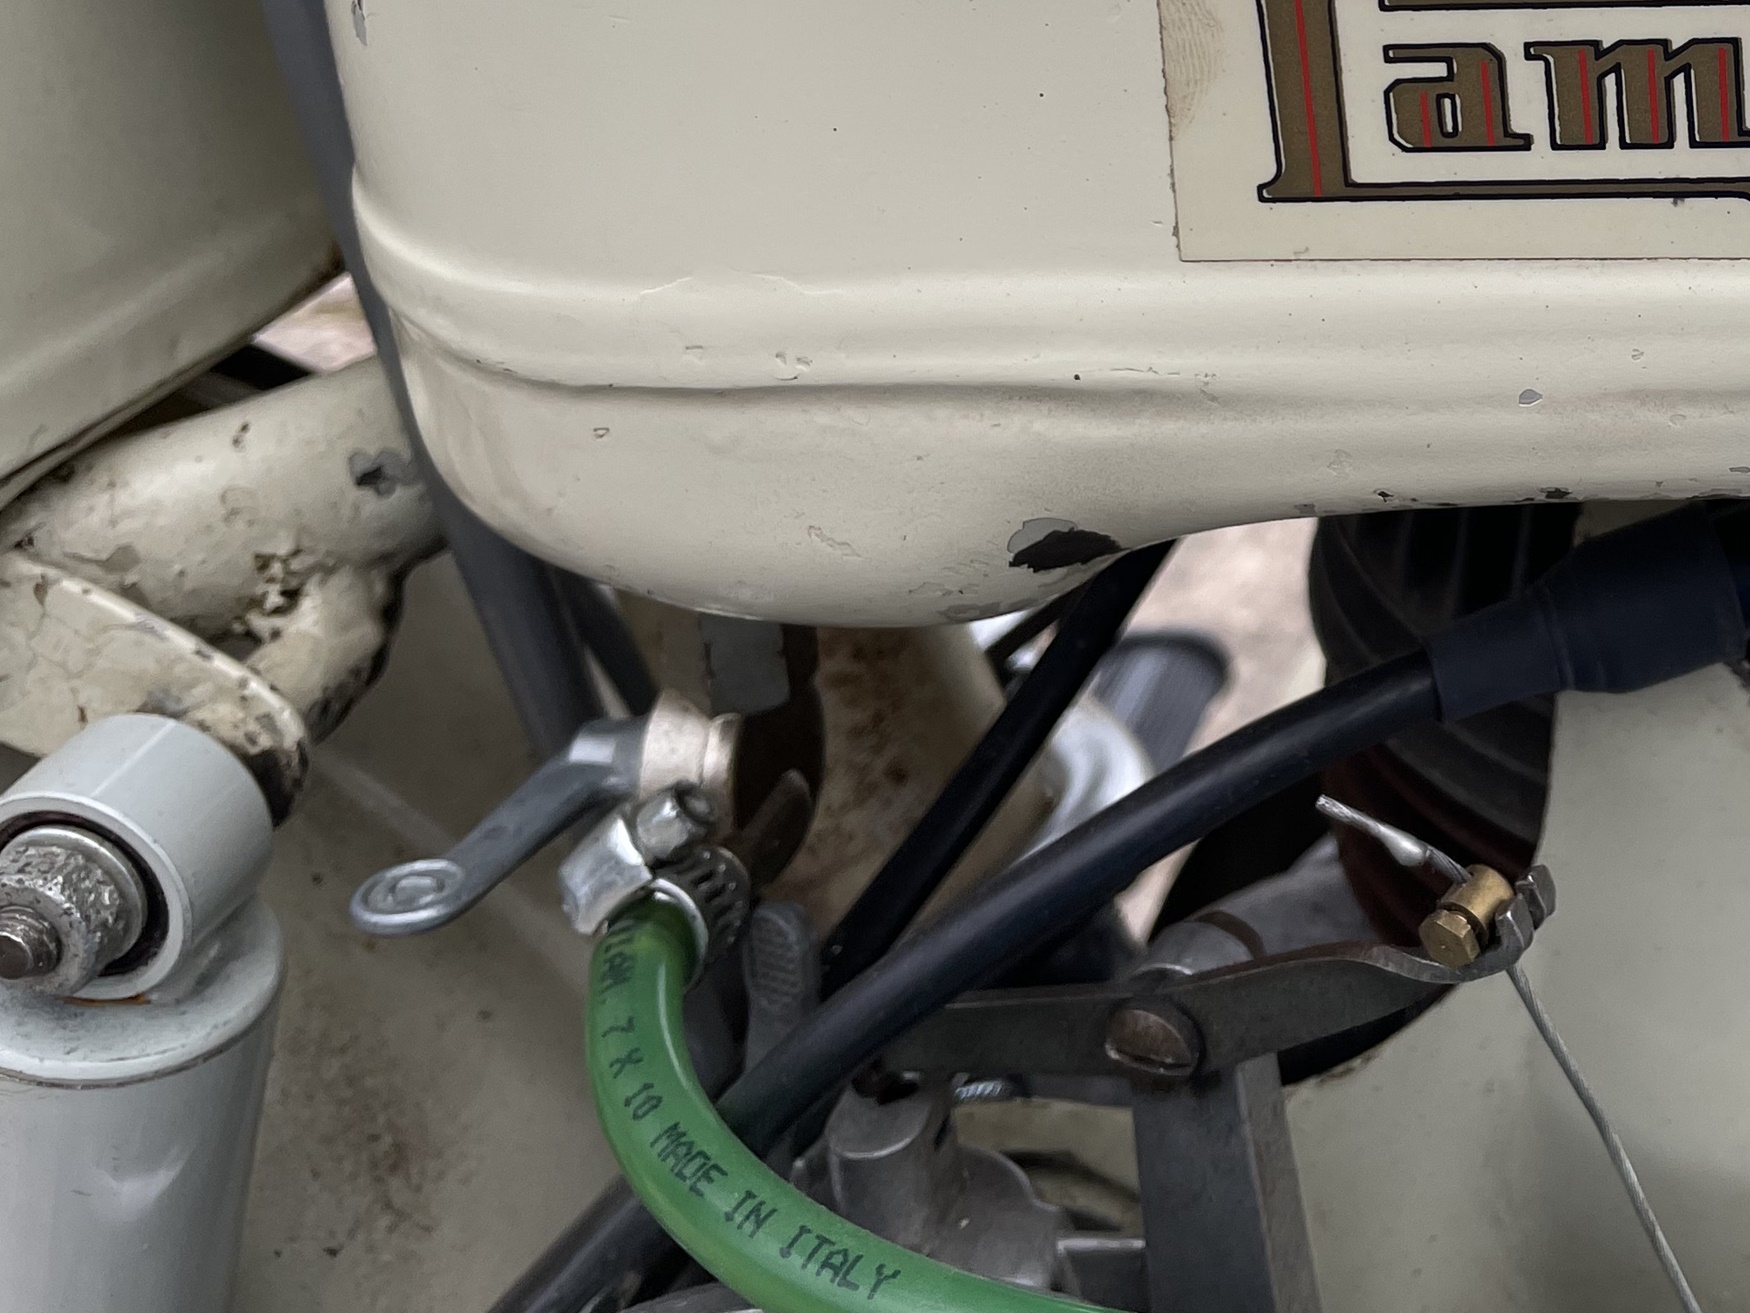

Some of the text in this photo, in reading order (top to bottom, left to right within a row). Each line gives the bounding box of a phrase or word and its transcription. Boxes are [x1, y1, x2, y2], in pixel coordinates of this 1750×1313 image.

[624, 1082, 663, 1122] 10
[650, 1121, 729, 1198] MADE
[724, 1189, 777, 1239] IN
[779, 1225, 902, 1301] ITALY
